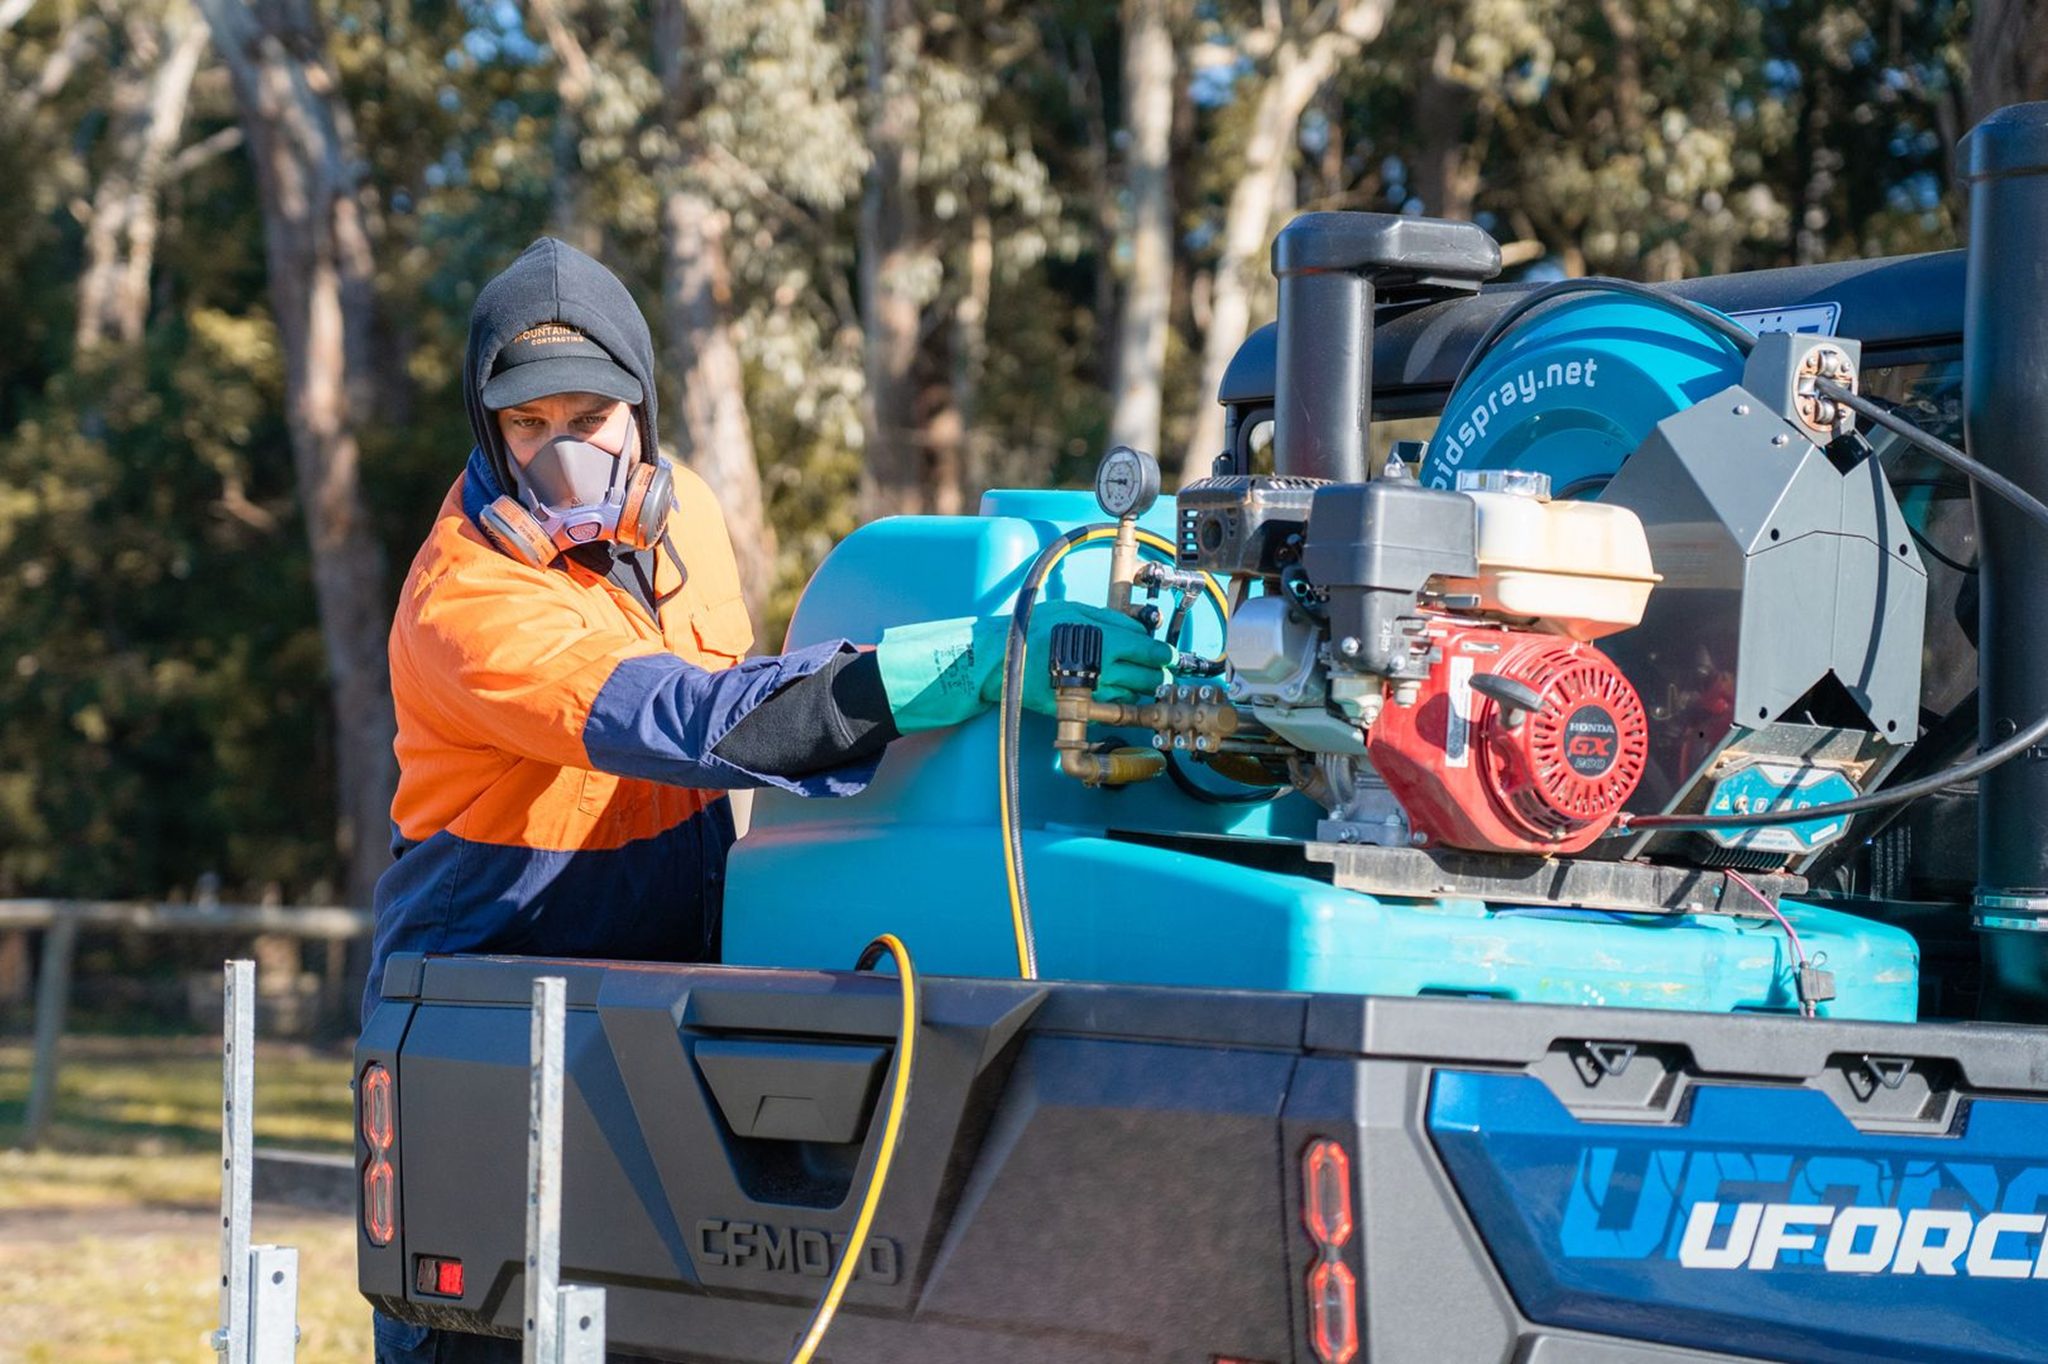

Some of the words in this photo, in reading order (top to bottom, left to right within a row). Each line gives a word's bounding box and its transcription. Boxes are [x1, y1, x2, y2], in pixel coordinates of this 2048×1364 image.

[1569, 722, 1615, 733] HONDA
[1569, 735, 1612, 756] GX
[696, 1219, 899, 1286] CFMOO
[1679, 1202, 2048, 1279] UFORC
